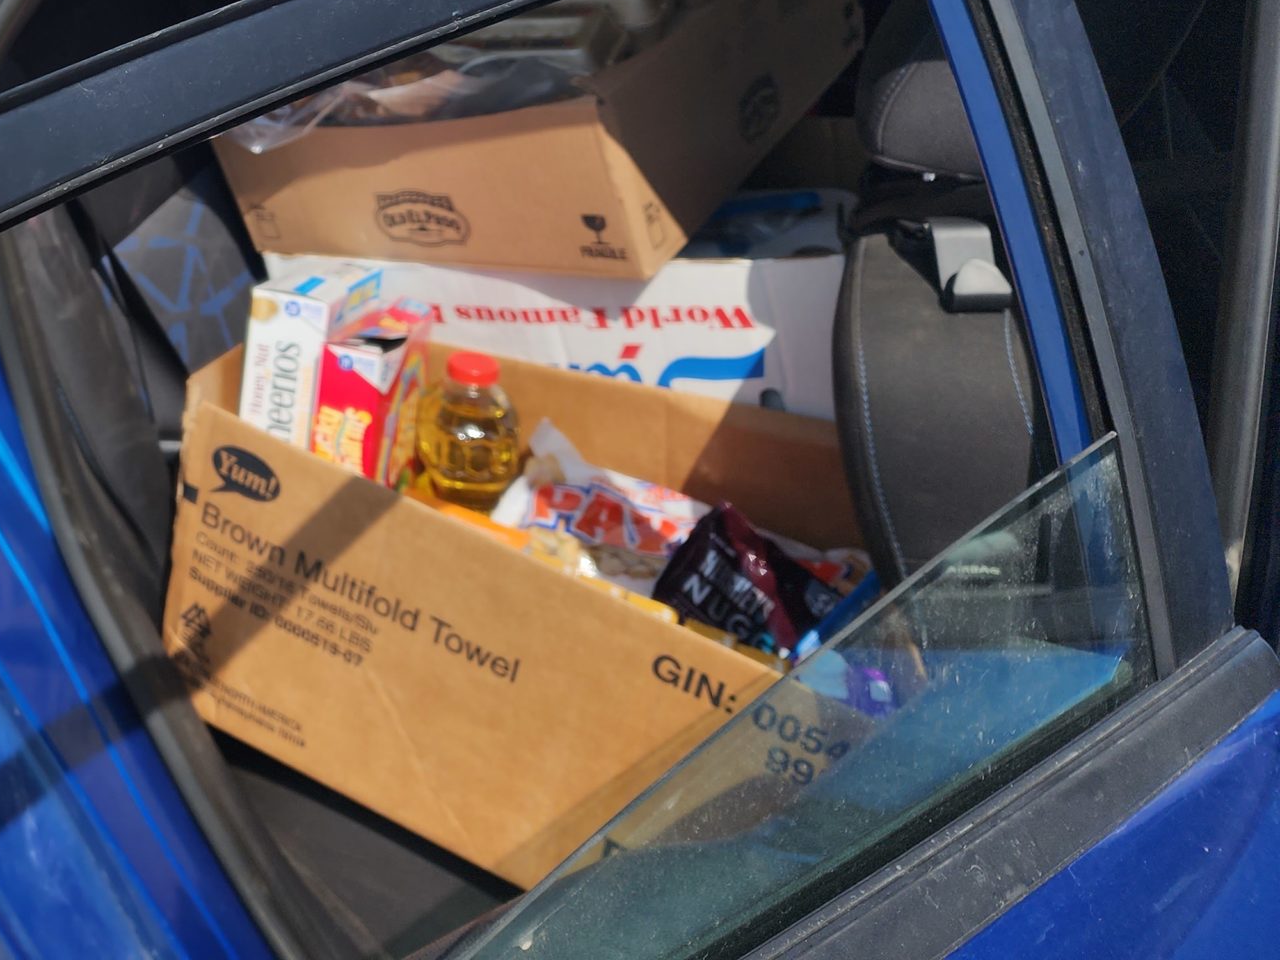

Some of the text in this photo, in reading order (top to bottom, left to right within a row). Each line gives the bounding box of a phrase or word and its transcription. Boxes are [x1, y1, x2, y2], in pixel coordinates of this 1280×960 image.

[455, 303, 610, 331] Famous
[622, 304, 756, 331] World
[250, 342, 270, 417] Honey Nut
[266, 340, 301, 445] heerios
[218, 449, 279, 500] Yum!
[189, 565, 246, 609] Supplier
[191, 548, 222, 573] NET
[338, 627, 373, 654] LBS
[201, 501, 521, 684] Brown Multifold Towel
[651, 653, 737, 715] GIN:
